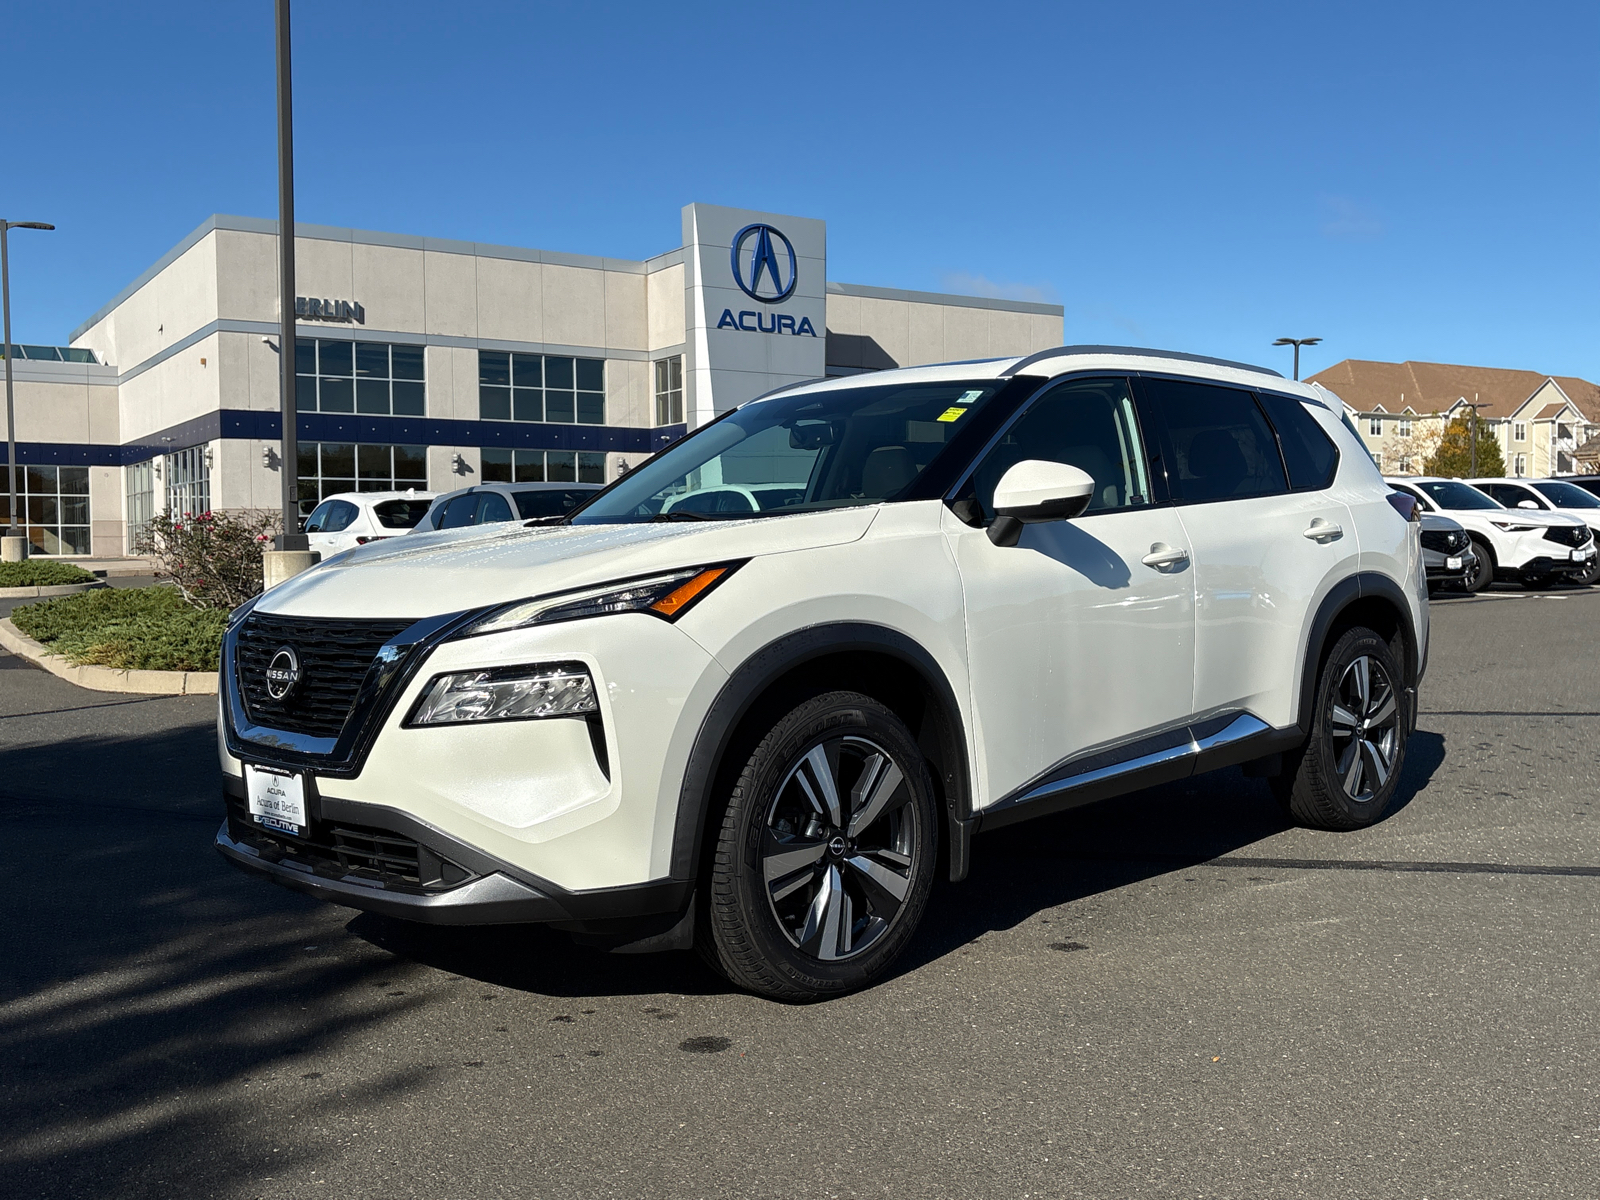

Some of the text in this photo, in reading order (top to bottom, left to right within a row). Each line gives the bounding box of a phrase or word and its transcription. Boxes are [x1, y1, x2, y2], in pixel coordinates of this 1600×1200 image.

[295, 297, 361, 320] ERLIN
[717, 309, 818, 338] ACURA
[266, 669, 298, 681] NISSAN
[267, 788, 286, 797] ACURA
[257, 796, 299, 814] Acura of Berlin
[253, 814, 299, 832] EXECUTIVE
